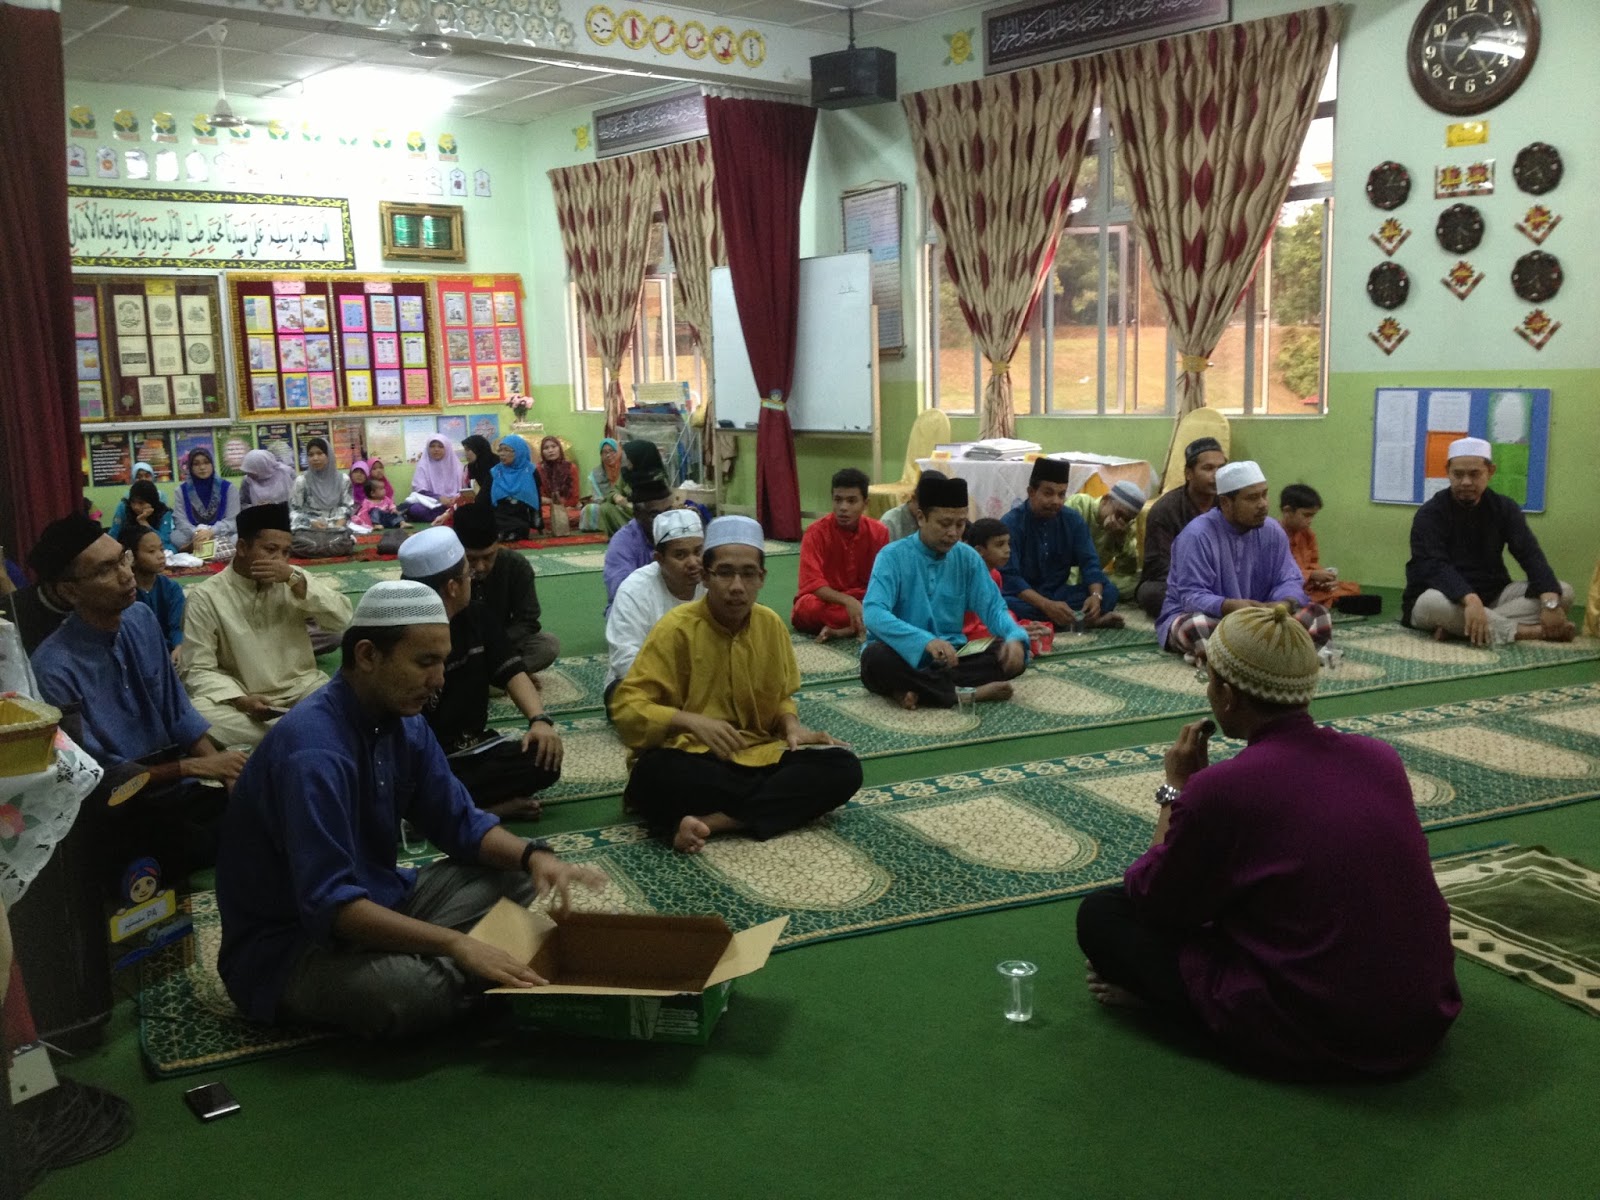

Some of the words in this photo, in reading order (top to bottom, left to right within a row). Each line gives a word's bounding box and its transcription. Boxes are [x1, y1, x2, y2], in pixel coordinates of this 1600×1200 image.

[1447, 6, 1458, 21] 11
[1503, 10, 1513, 26] 2
[1433, 23, 1447, 38] 10
[1506, 30, 1519, 45] 3
[1425, 45, 1436, 59] 9
[1498, 53, 1509, 67] 4
[1432, 64, 1443, 78] 8
[1485, 70, 1497, 85] 5
[1447, 75, 1457, 90] 7
[1464, 79, 1476, 93] 6
[147, 908, 157, 919] PA
